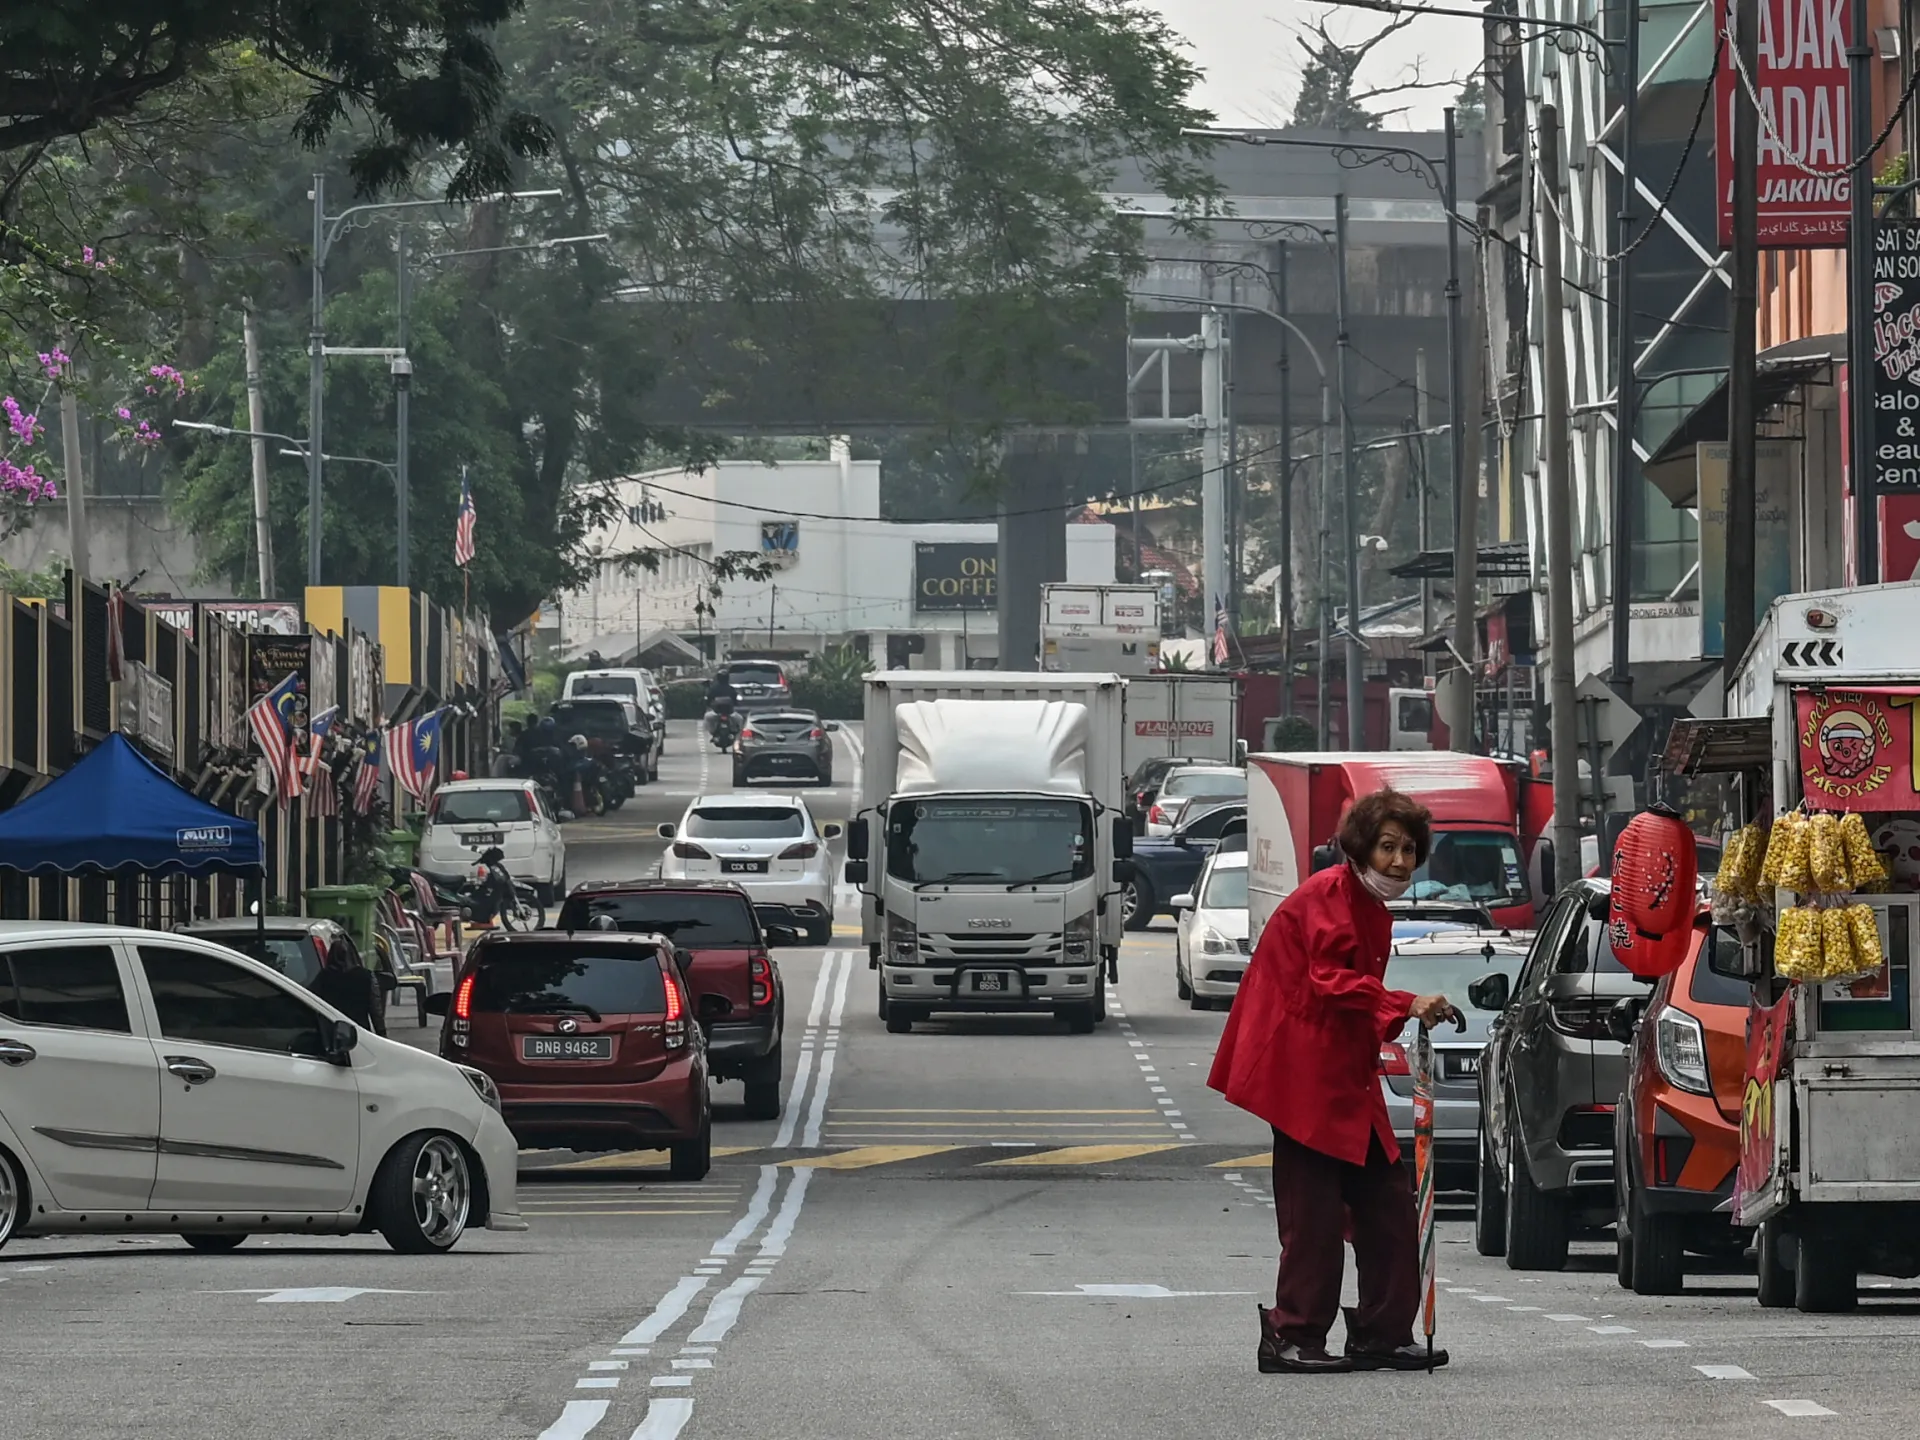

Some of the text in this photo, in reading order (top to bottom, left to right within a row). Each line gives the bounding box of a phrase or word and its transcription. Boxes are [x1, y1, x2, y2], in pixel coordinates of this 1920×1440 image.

[1873, 255, 1920, 279] AN SO
[1896, 416, 1916, 437] &
[1147, 722, 1213, 733] LALAMOVE
[1804, 764, 1893, 798] TAKOYAKI
[183, 829, 225, 840] MUTU
[967, 918, 1012, 928] ISUZU
[535, 1041, 598, 1053] BNB 9462
